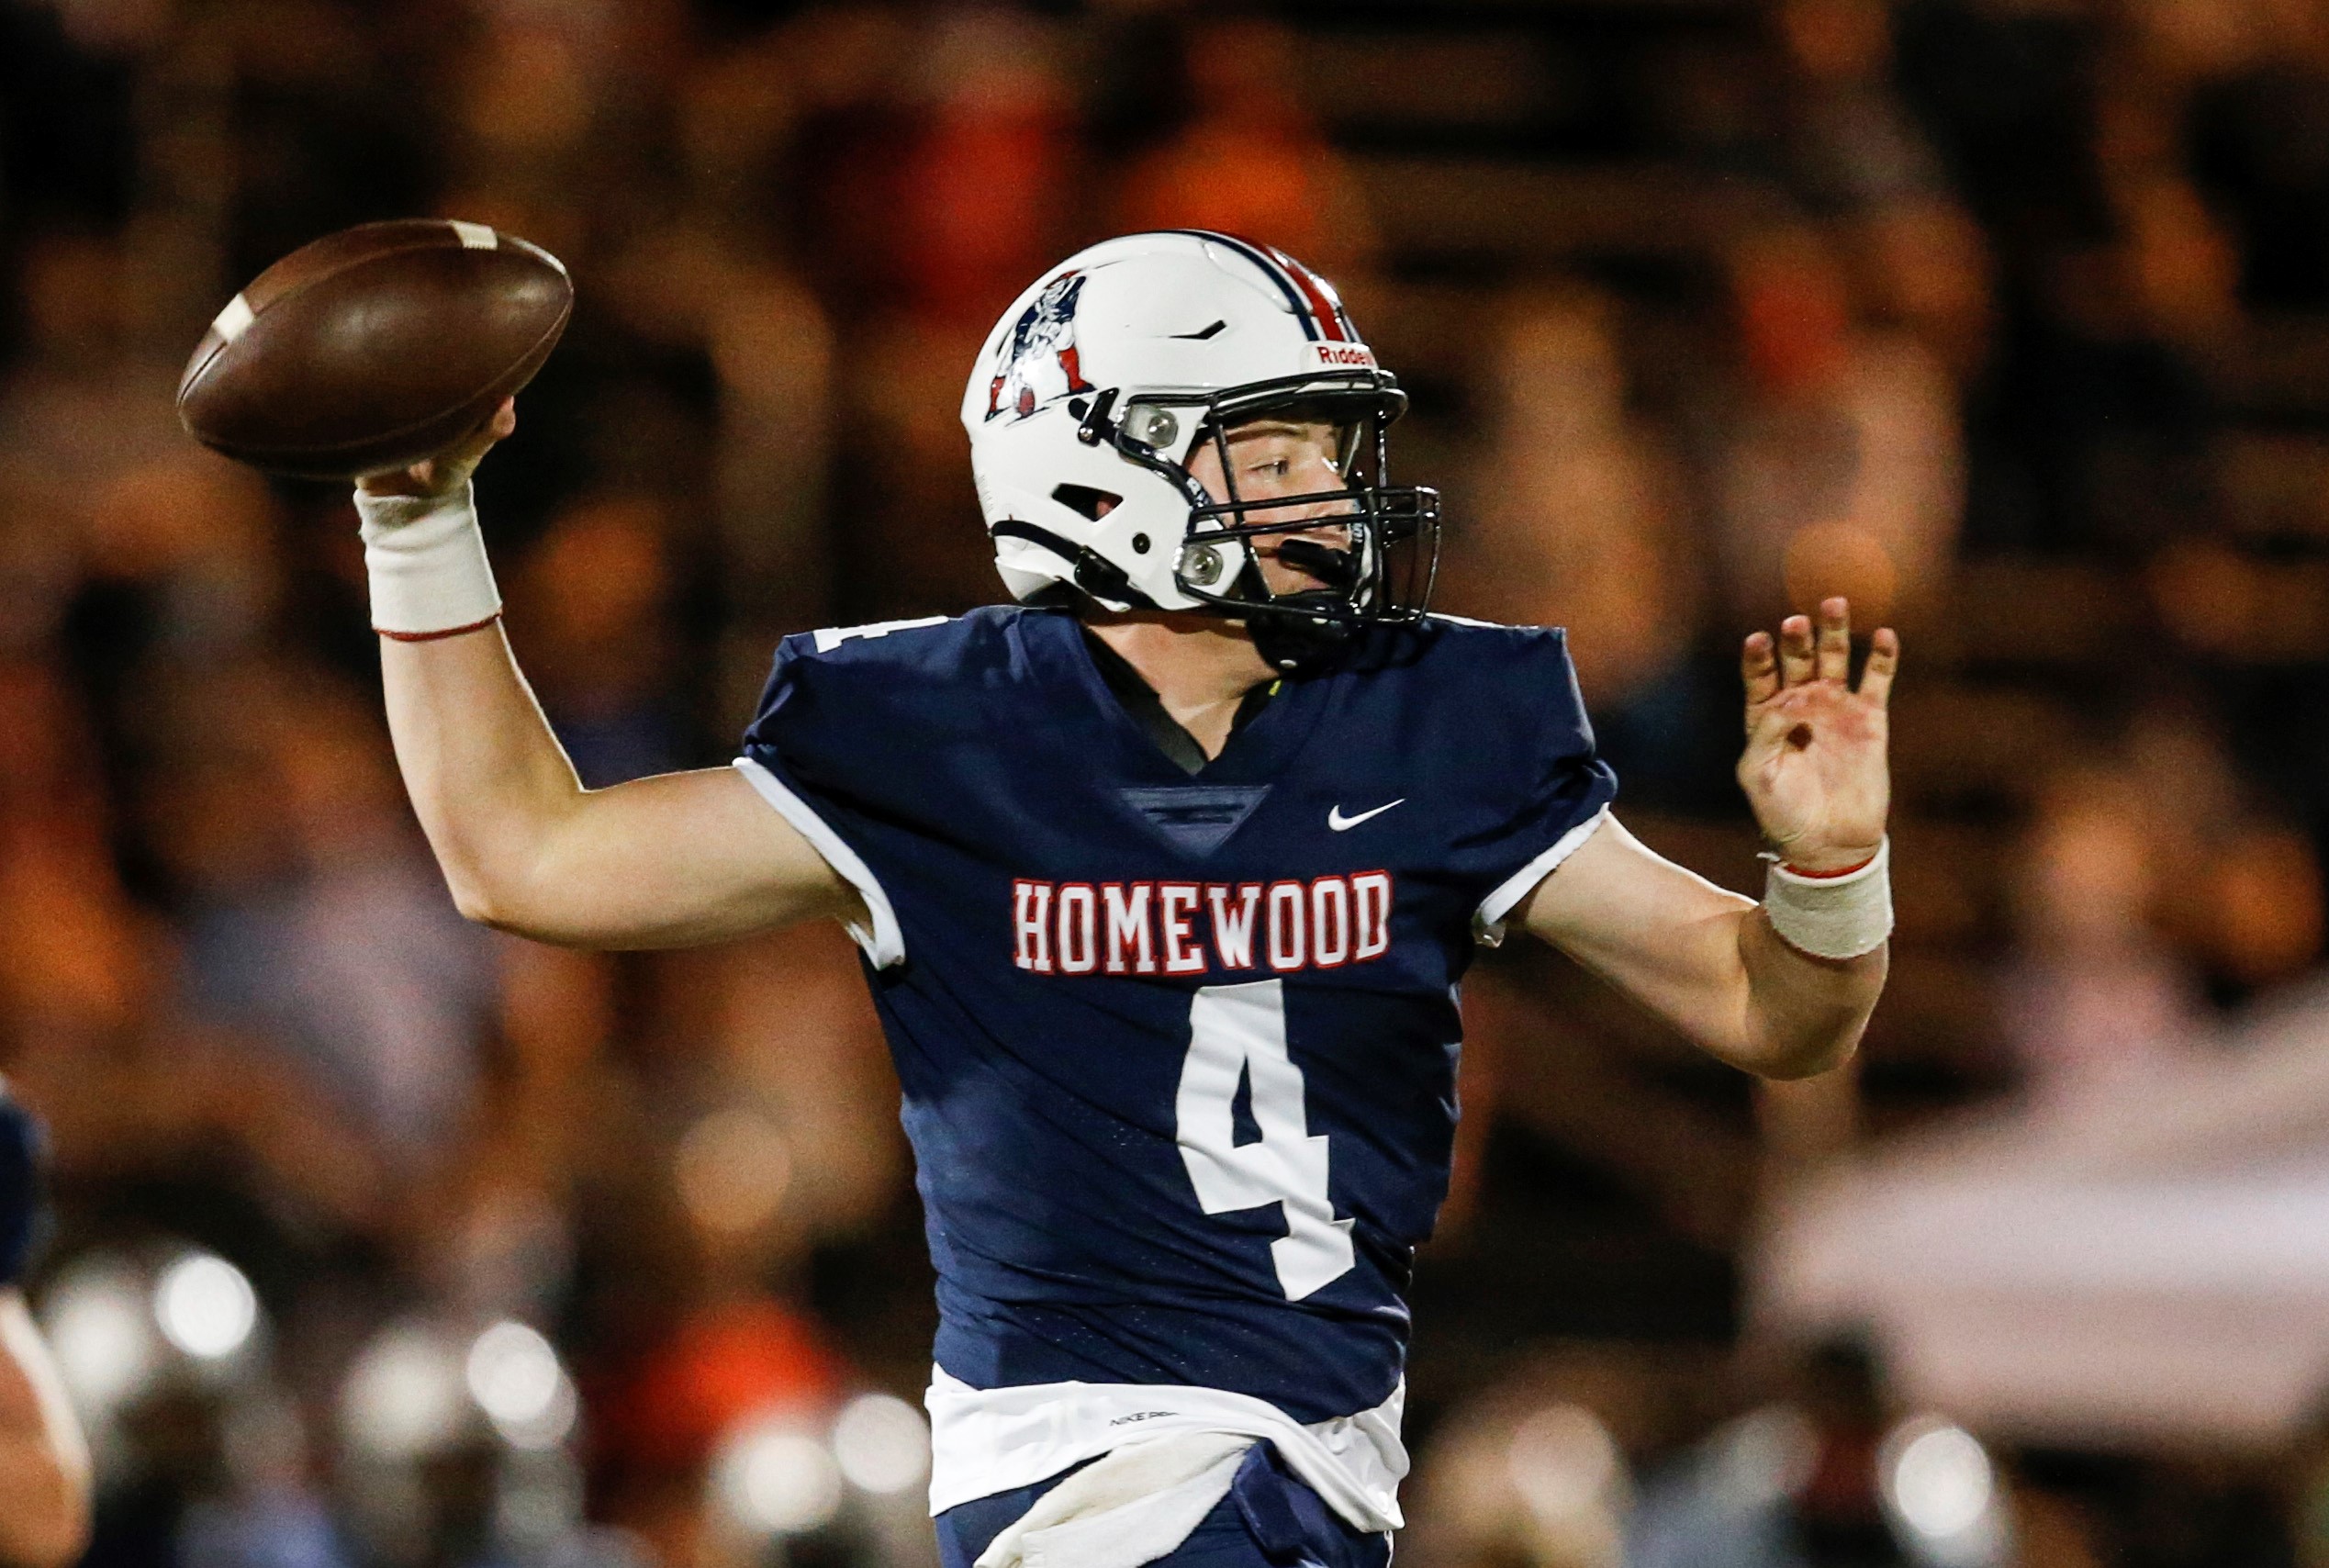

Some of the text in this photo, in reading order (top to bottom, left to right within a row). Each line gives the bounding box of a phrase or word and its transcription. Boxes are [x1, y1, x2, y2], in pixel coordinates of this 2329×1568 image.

[1317, 346, 1374, 365] Ridde
[1012, 868, 1394, 976] HOMEWOOD
[1176, 978, 1356, 1302] 4
